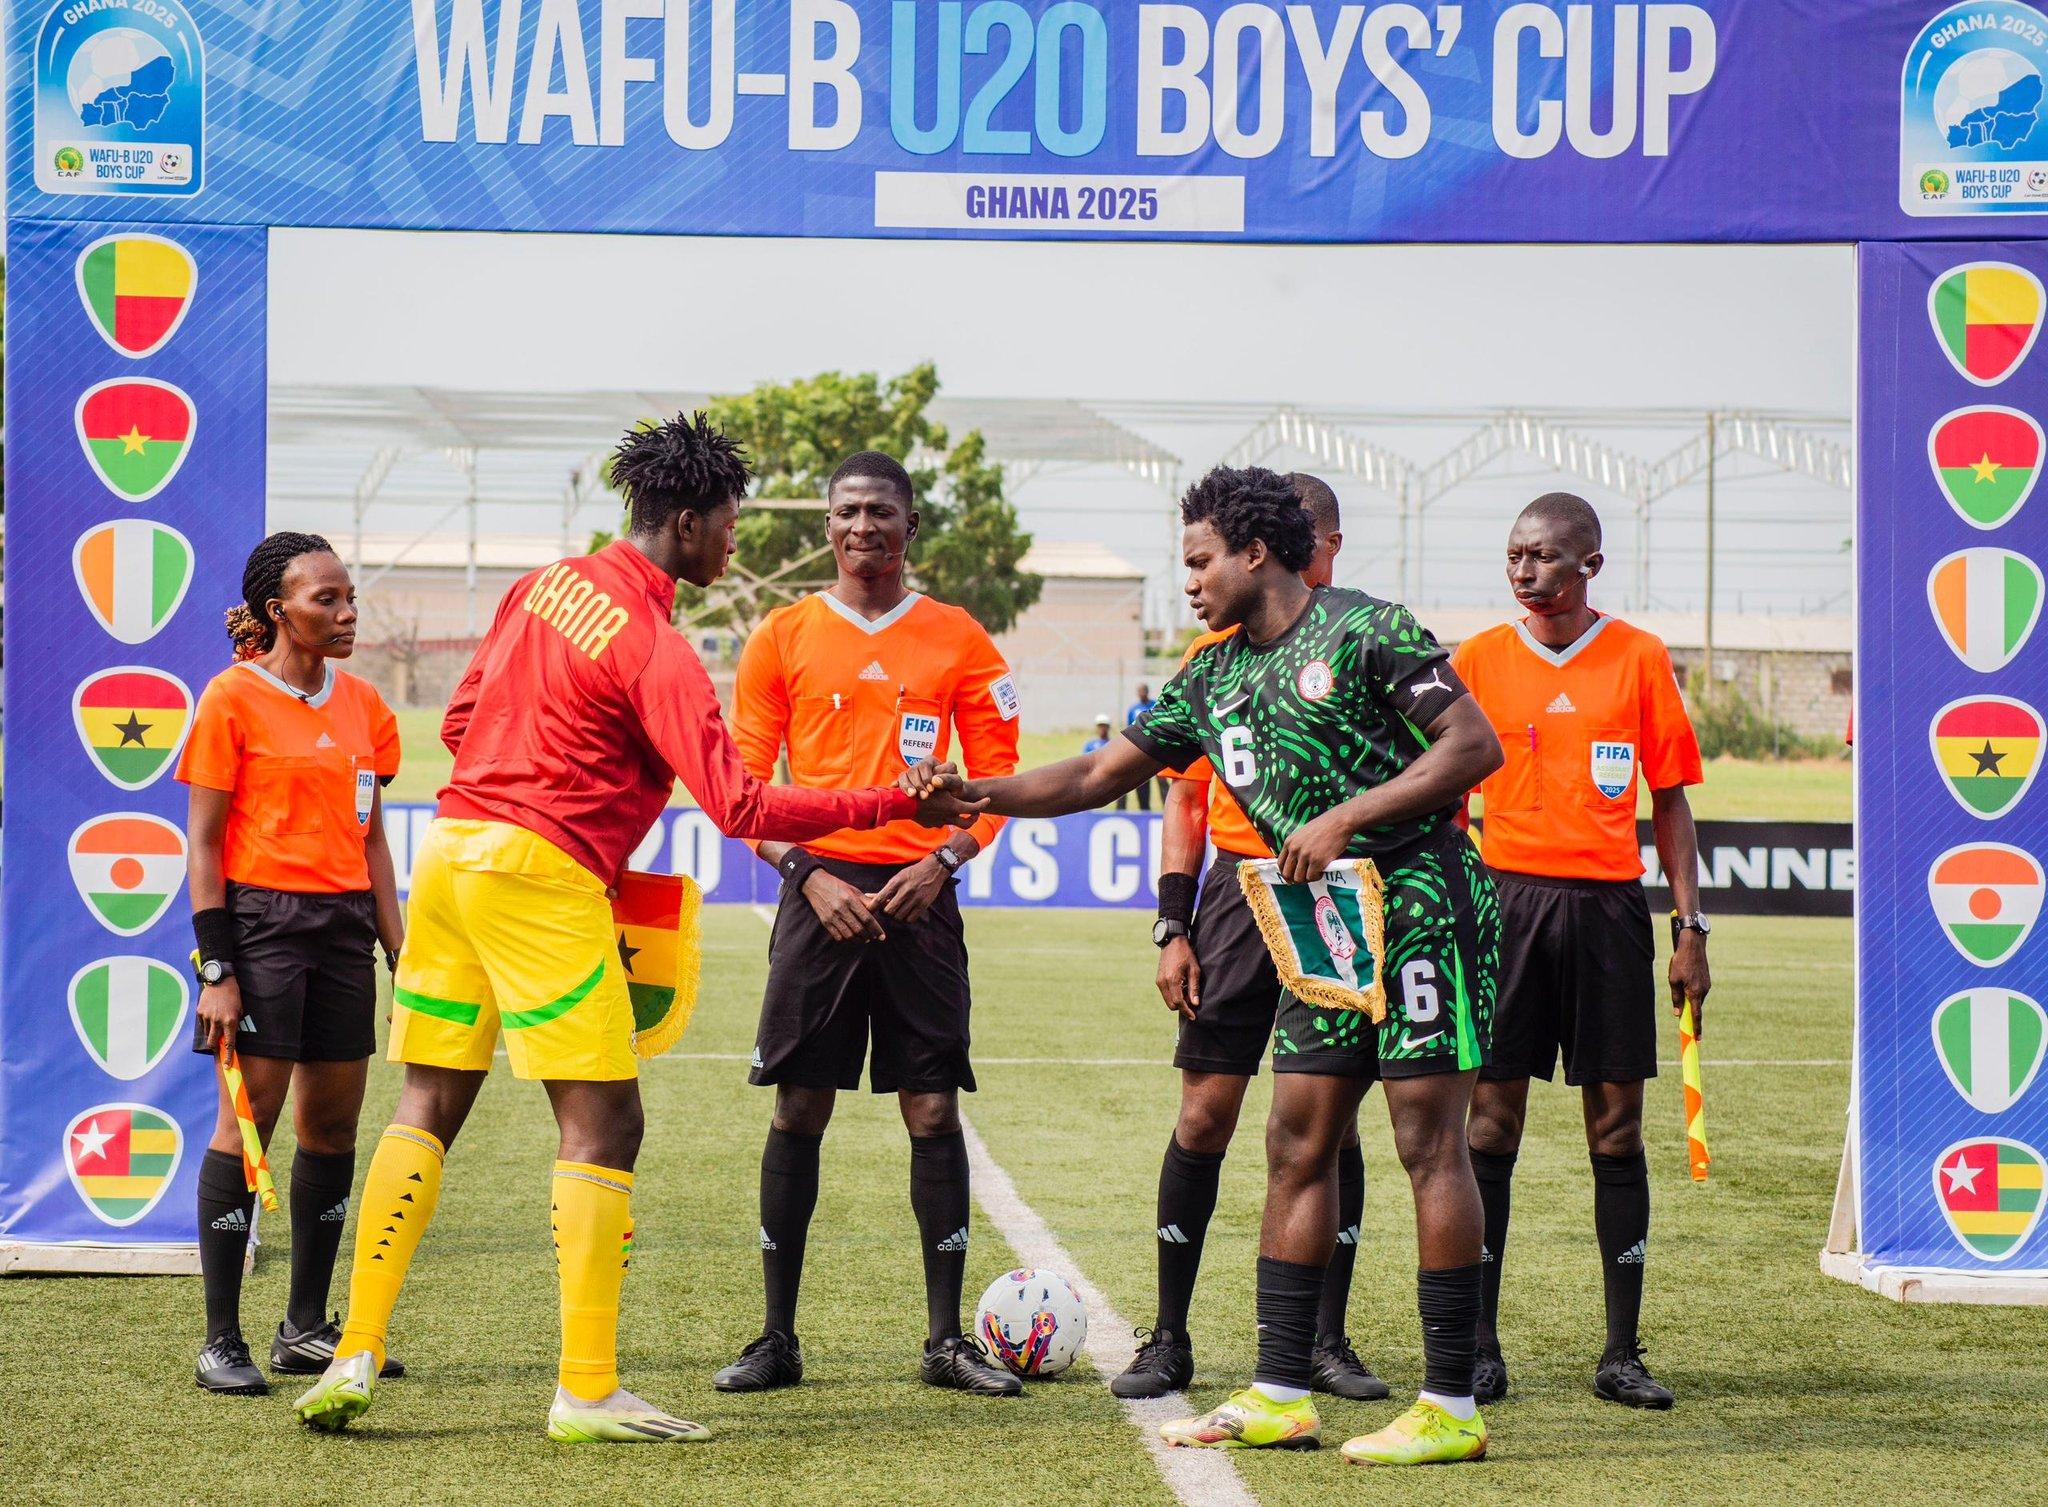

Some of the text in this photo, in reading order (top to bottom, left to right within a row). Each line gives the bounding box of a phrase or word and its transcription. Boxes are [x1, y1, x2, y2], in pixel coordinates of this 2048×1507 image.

[63, 0, 179, 29] GHANA 2025
[1931, 13, 2047, 48] GHANA 2025
[413, 0, 862, 150] WAFU-B
[890, 0, 1108, 157] U20
[1492, 2, 1717, 159] CUP
[89, 148, 154, 164] WAFU-B U20
[96, 165, 123, 179] BOYS
[124, 166, 146, 180] CUP
[1955, 169, 2021, 184] WAFU-B U20
[1962, 185, 1989, 199] BOYS
[1991, 184, 2012, 199] CUP
[965, 184, 1159, 221] GHANA 2025
[523, 562, 630, 661] GHANA
[905, 717, 935, 733] FIFA
[903, 739, 933, 749] REFEREE
[1220, 725, 1257, 788] 6
[1596, 746, 1630, 760] FIFA
[358, 773, 373, 788] FIFA
[1604, 786, 1621, 794] 2025
[1400, 959, 1440, 1023] 6
[211, 1211, 346, 1231] adidas adid
